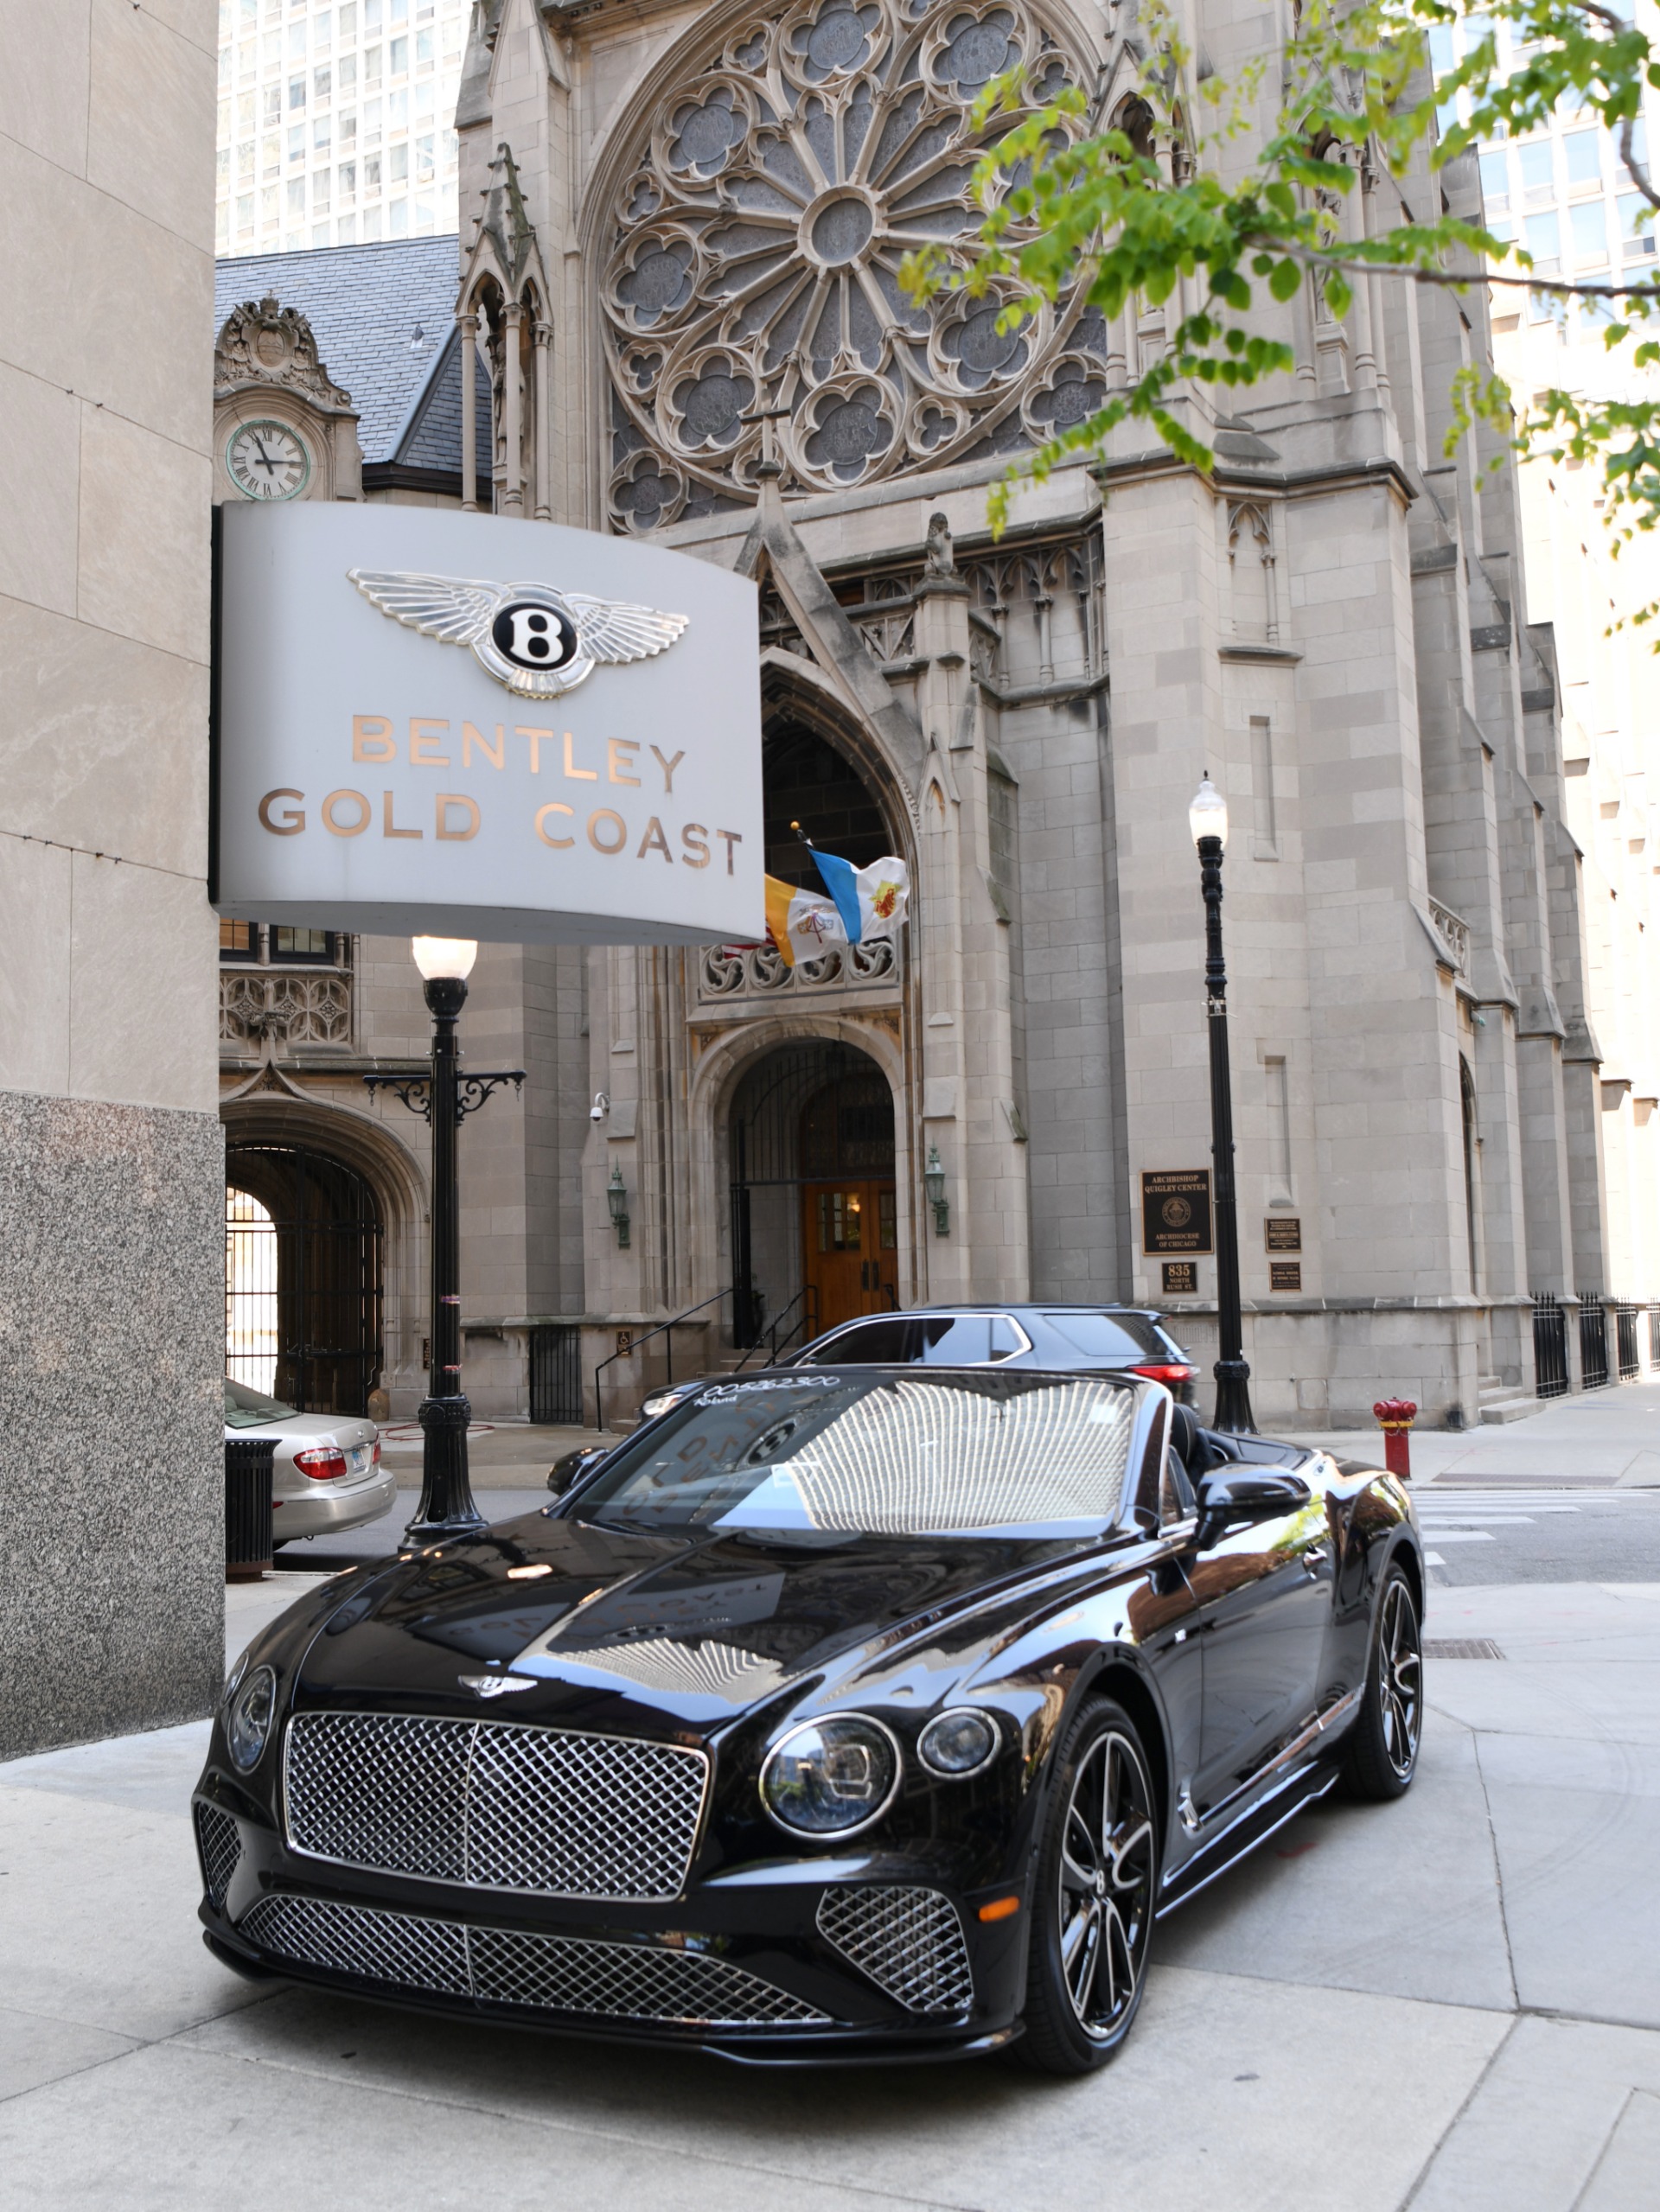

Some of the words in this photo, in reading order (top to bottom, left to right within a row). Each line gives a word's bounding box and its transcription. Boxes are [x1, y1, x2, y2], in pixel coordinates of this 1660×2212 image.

[262, 429, 273, 443] XII
[278, 433, 286, 446] I
[235, 438, 250, 452] X
[285, 447, 299, 456] II
[233, 455, 246, 464] IX
[278, 481, 287, 494] V
[510, 608, 564, 665] B
[352, 714, 686, 793] BENTLEY
[259, 787, 481, 842] GOLD
[534, 803, 743, 877] COAST
[1152, 1175, 1199, 1183] ARCHBISHOP
[1145, 1184, 1176, 1194] QUIGLEY
[1168, 1264, 1191, 1277] 835
[693, 1394, 738, 1406] Roland
